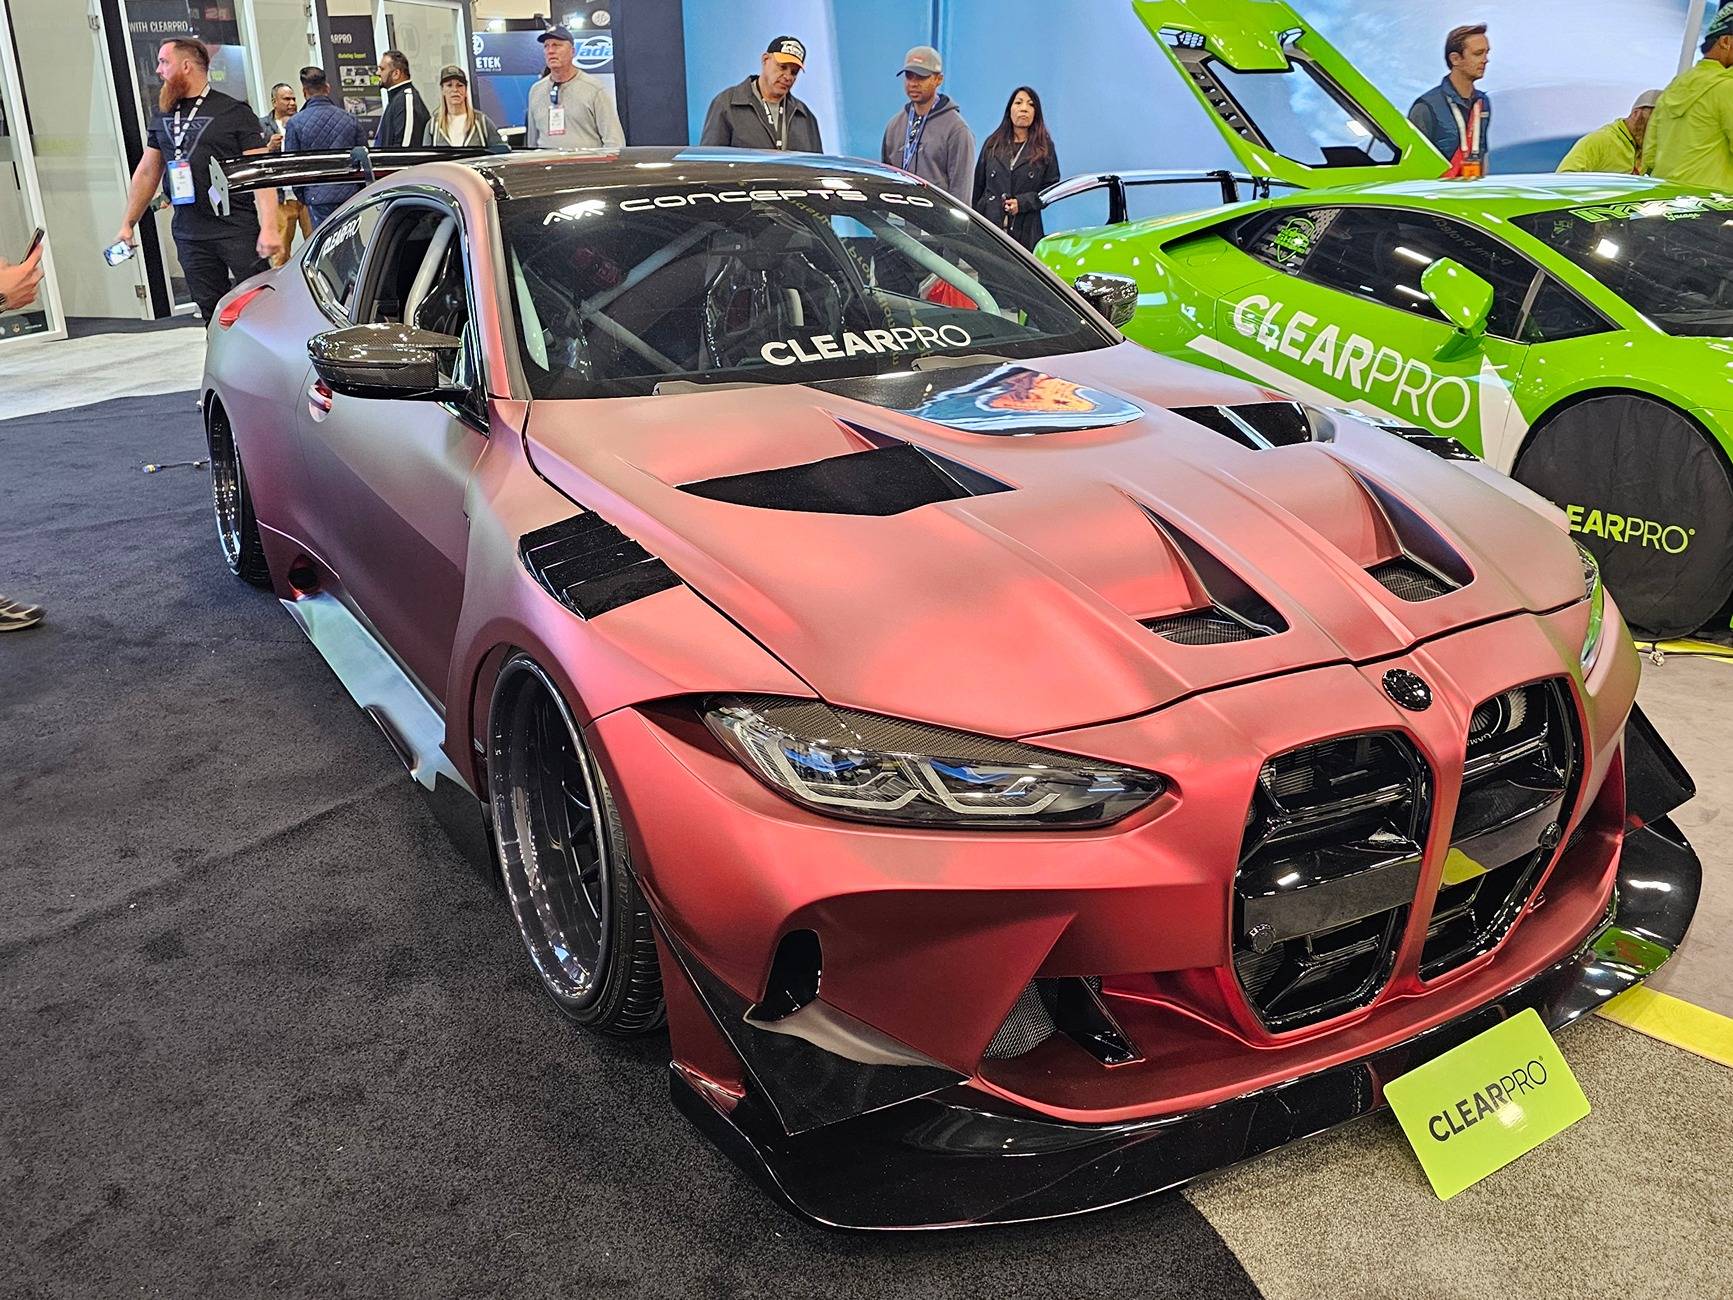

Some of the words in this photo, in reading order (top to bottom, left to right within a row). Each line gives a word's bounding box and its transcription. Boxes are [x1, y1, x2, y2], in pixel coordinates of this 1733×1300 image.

[129, 21, 148, 32] WITH
[150, 21, 188, 32] CLEARPRO
[331, 33, 352, 44] ARPRO
[475, 56, 501, 69] ETEK
[619, 189, 868, 212] CONCEPTS
[879, 193, 933, 208] CO
[761, 324, 972, 366] CLEARPRO
[1233, 294, 1471, 429] CLEARPRO
[1567, 503, 1690, 554] EARPRO
[1428, 1060, 1547, 1142] CLEARPRO
